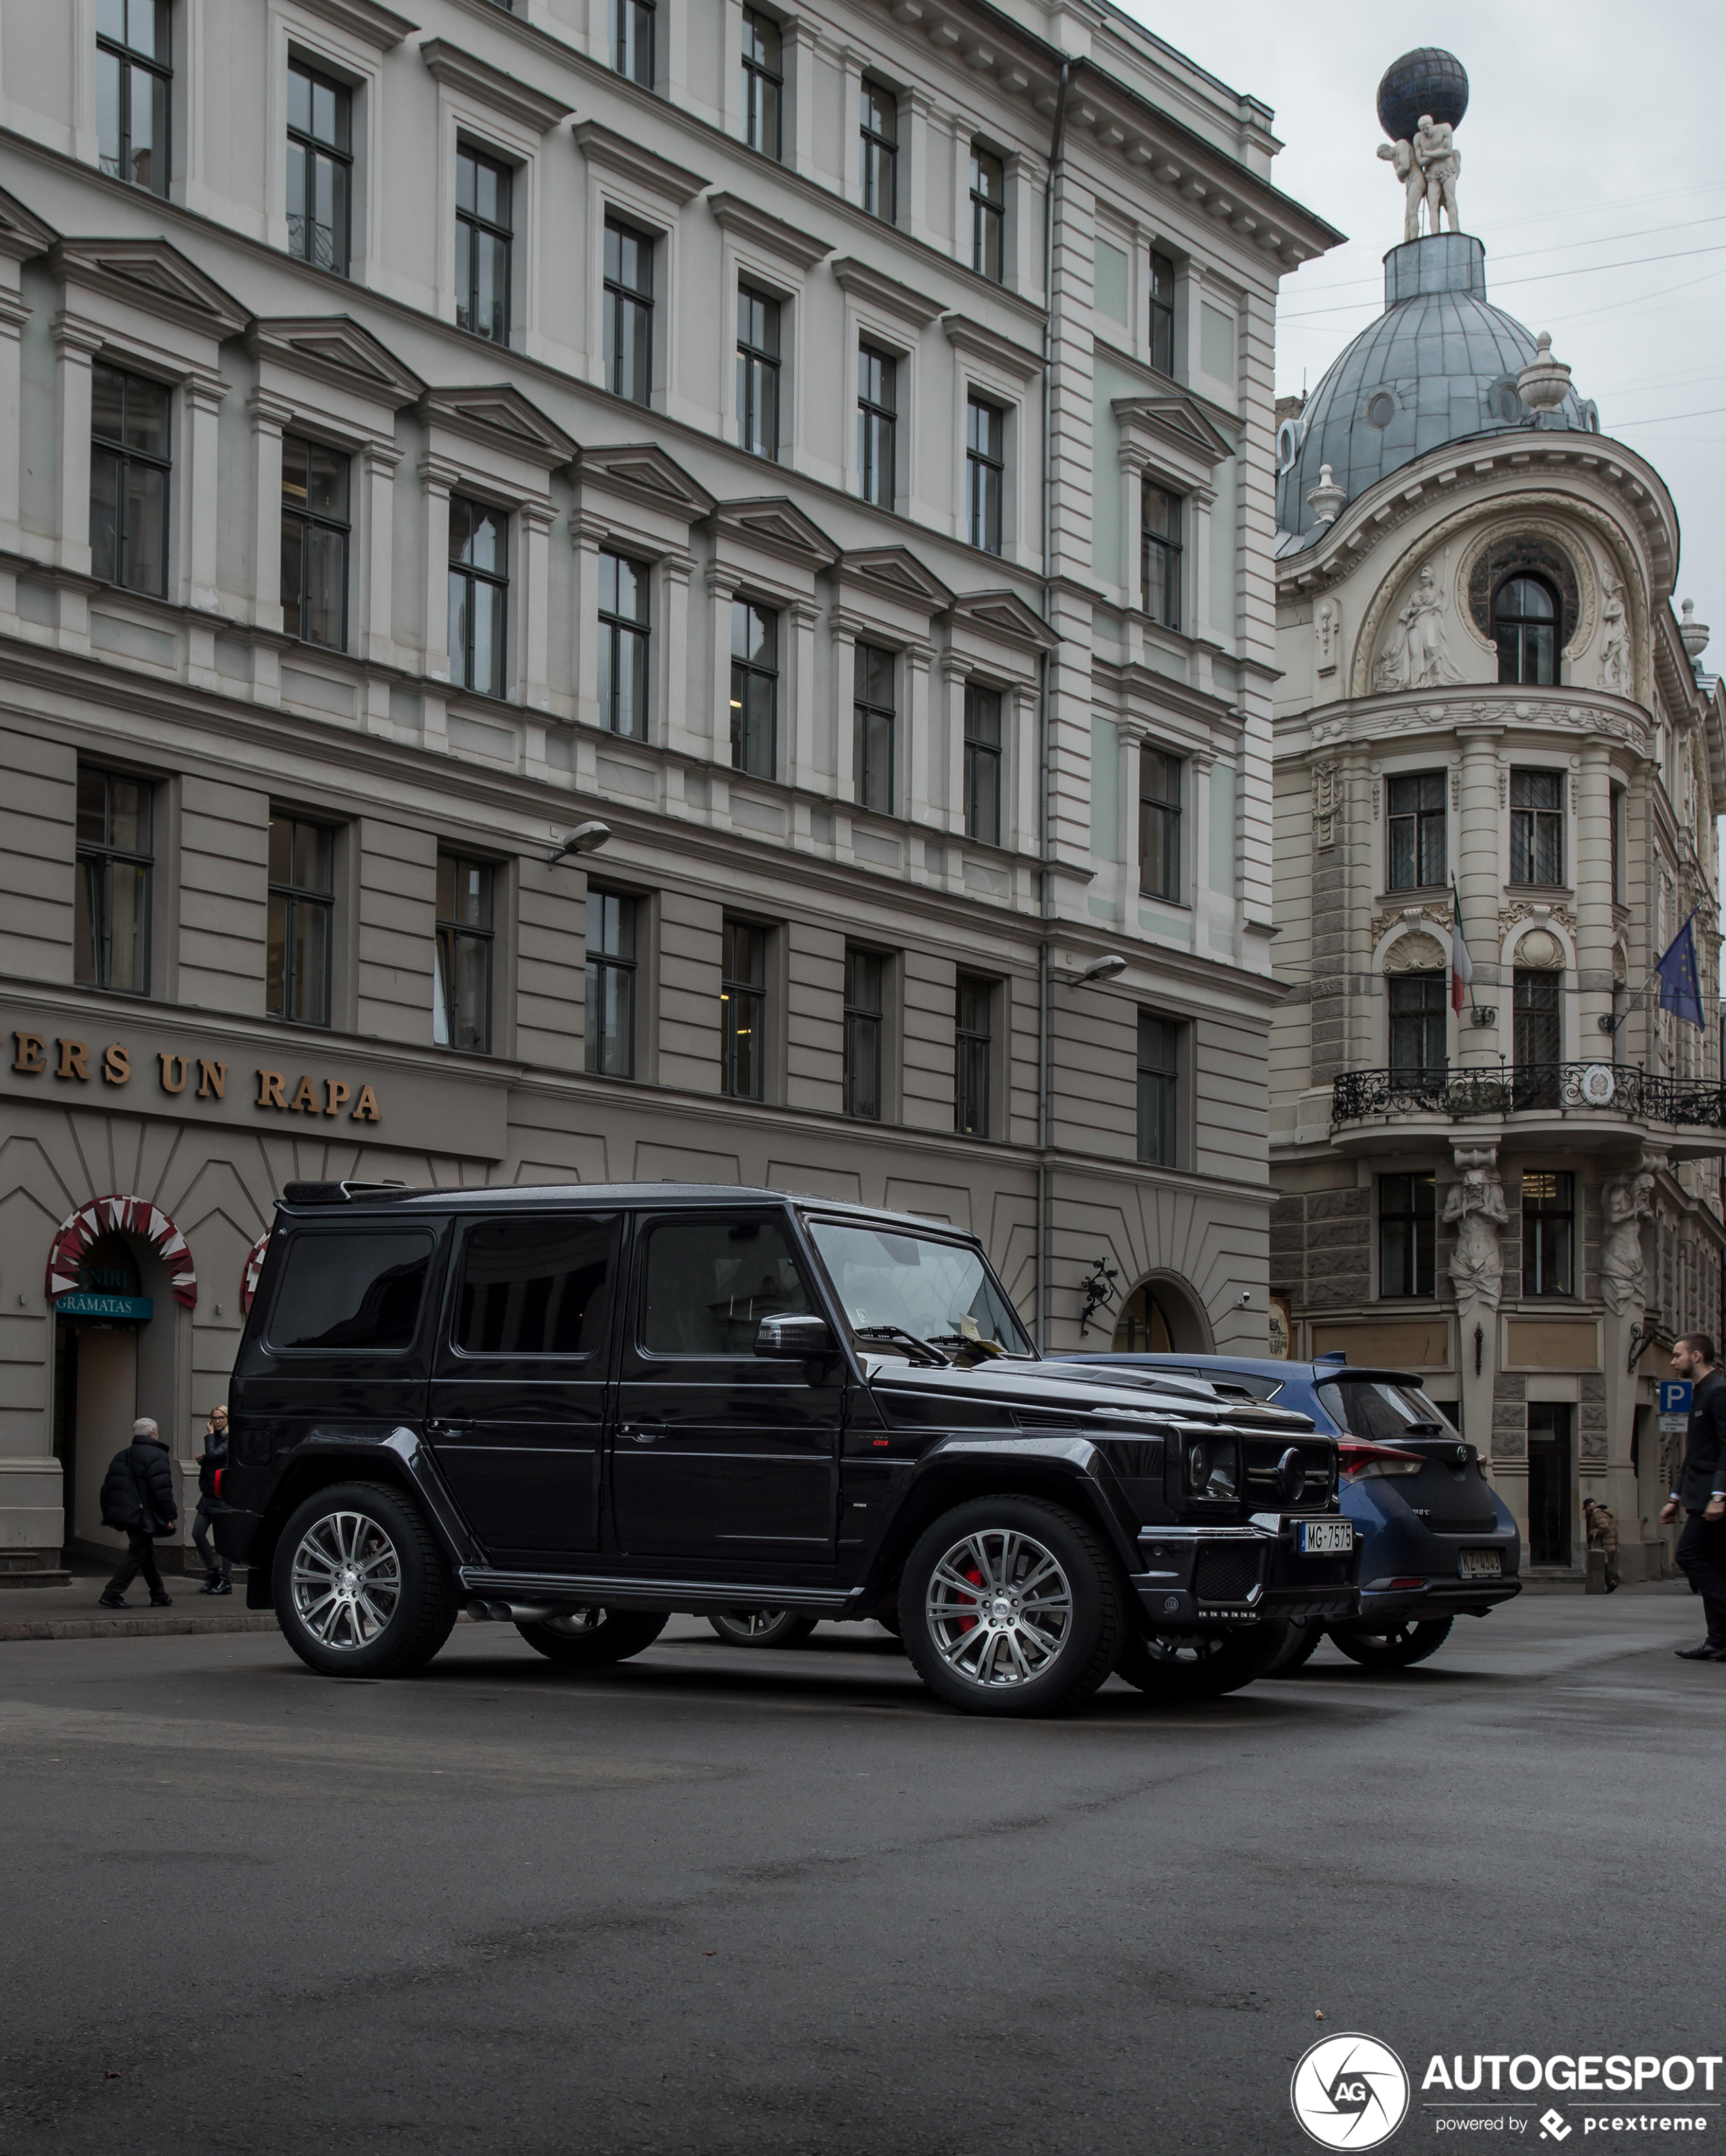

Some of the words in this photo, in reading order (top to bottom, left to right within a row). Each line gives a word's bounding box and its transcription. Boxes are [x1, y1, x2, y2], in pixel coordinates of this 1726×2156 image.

[0, 1031, 131, 1084] ERS
[157, 1053, 229, 1098] UN
[255, 1069, 383, 1120] RAPA
[56, 1294, 132, 1313] GRĀMATAS
[1667, 1385, 1685, 1409] P
[1308, 1525, 1351, 1549] MG-7575
[1462, 1553, 1500, 1571] KZ-4343
[1167, 1600, 1176, 1609] B
